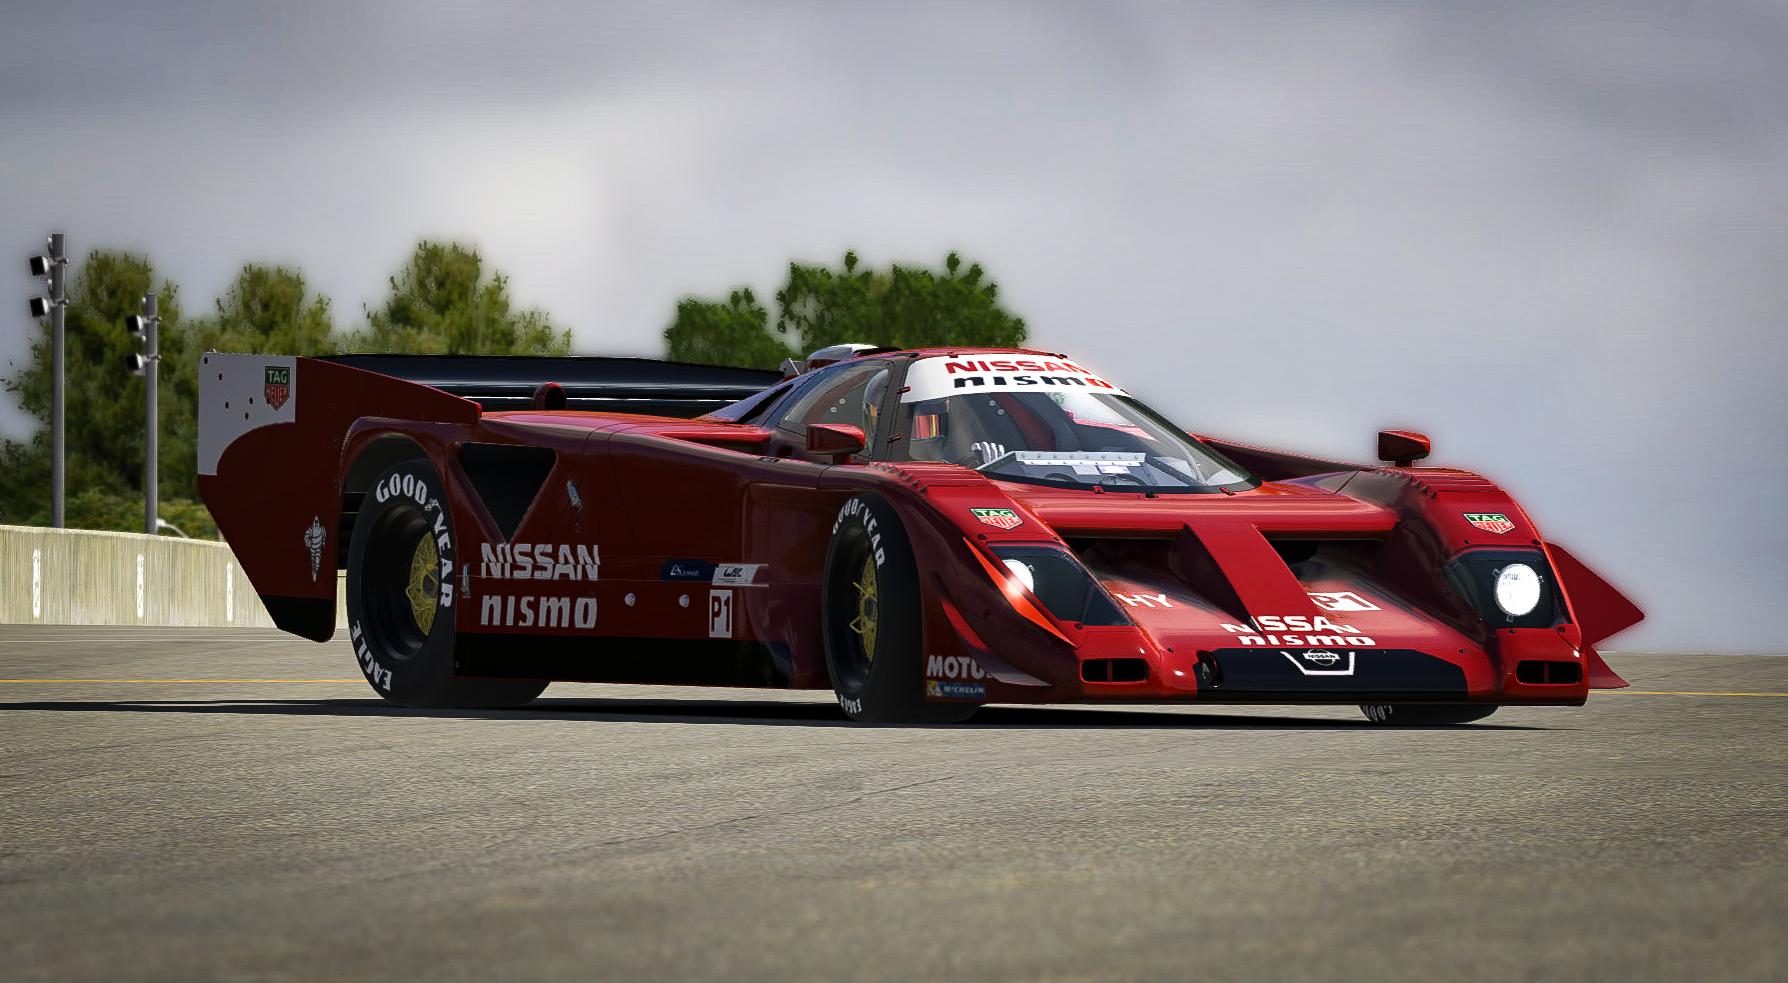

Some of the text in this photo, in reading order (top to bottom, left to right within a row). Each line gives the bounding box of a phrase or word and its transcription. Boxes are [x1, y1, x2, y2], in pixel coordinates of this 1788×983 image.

[944, 360, 1094, 375] NISSAN
[267, 370, 287, 384] TAG
[266, 386, 289, 406] HEUER
[980, 516, 1021, 529] HEUER
[1472, 521, 1514, 534] HEUER
[480, 542, 601, 581] NISSAN
[1114, 593, 1174, 608] HY
[1309, 594, 1373, 609] P1
[711, 595, 731, 632] P1
[351, 619, 393, 692] EAGLE
[943, 683, 985, 694] MICHELIN
